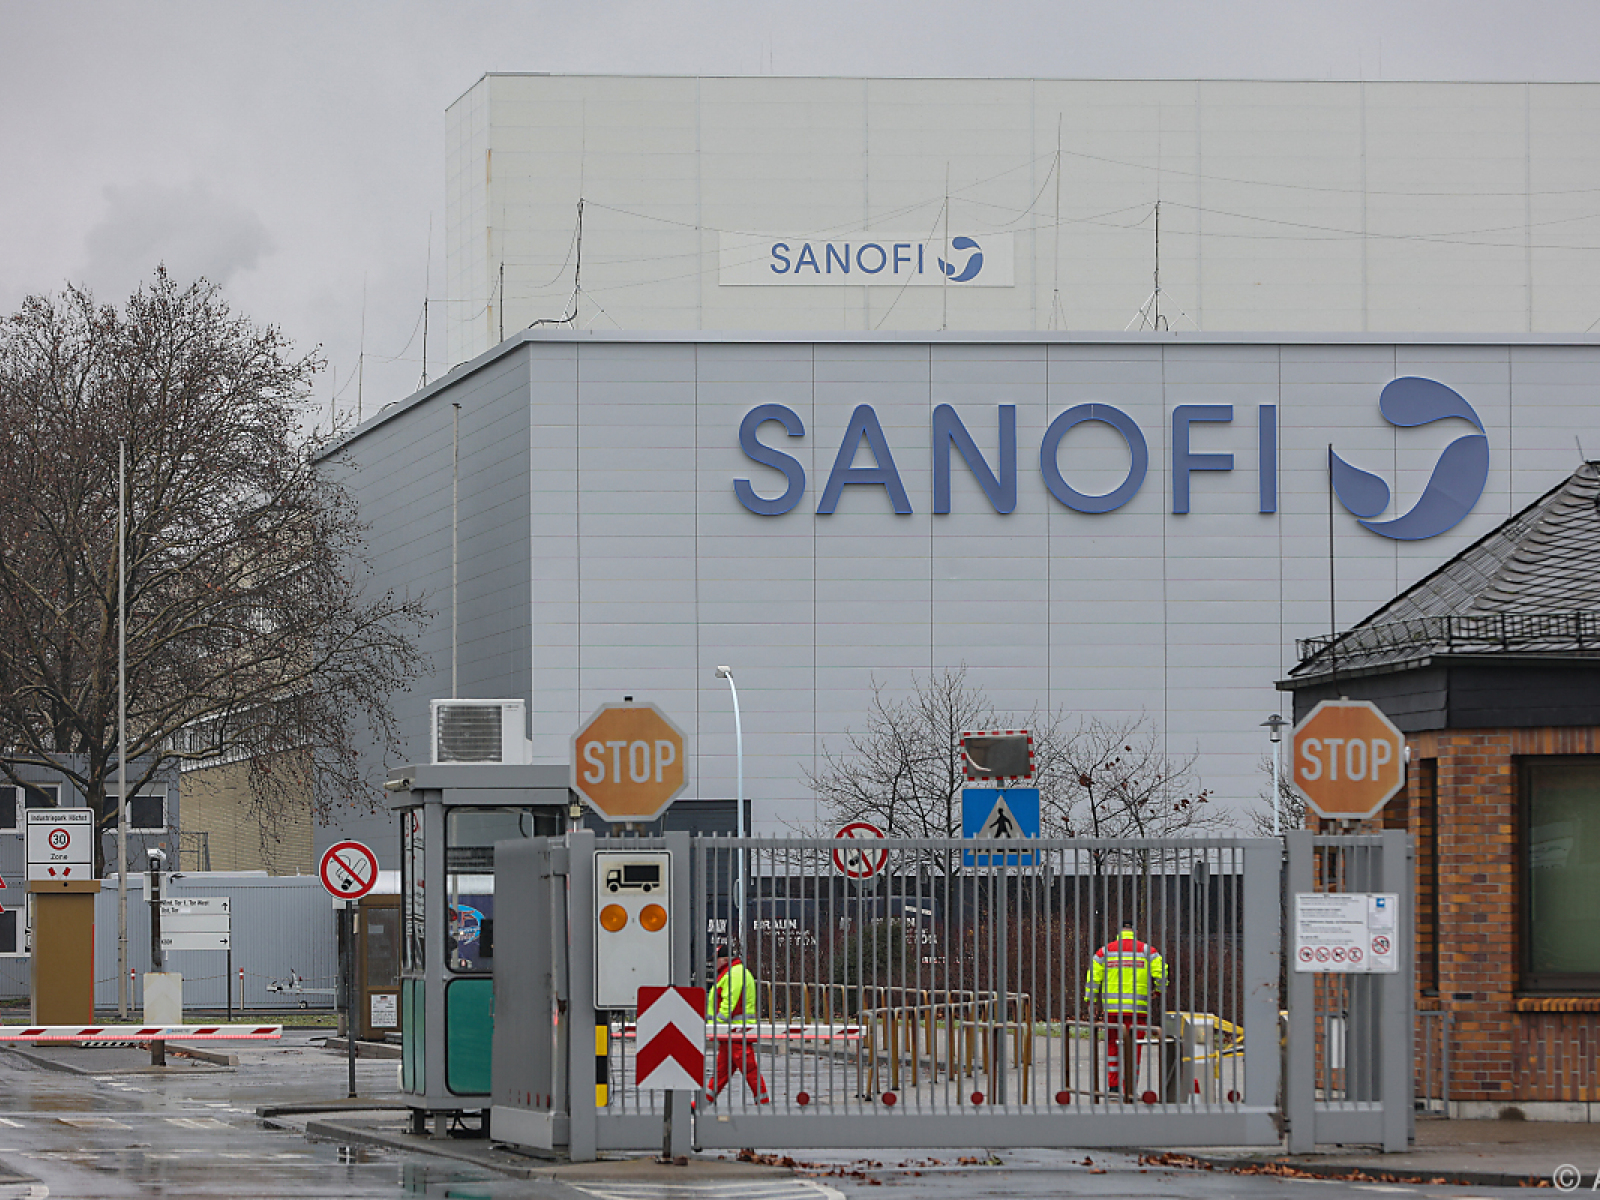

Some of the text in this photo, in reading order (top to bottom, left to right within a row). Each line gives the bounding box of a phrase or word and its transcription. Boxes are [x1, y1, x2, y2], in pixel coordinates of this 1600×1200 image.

[770, 242, 923, 274] SANOFI
[733, 402, 1277, 516] SANOFI
[583, 740, 675, 784] STOP
[1301, 737, 1391, 781] STOP
[53, 833, 66, 845] 30
